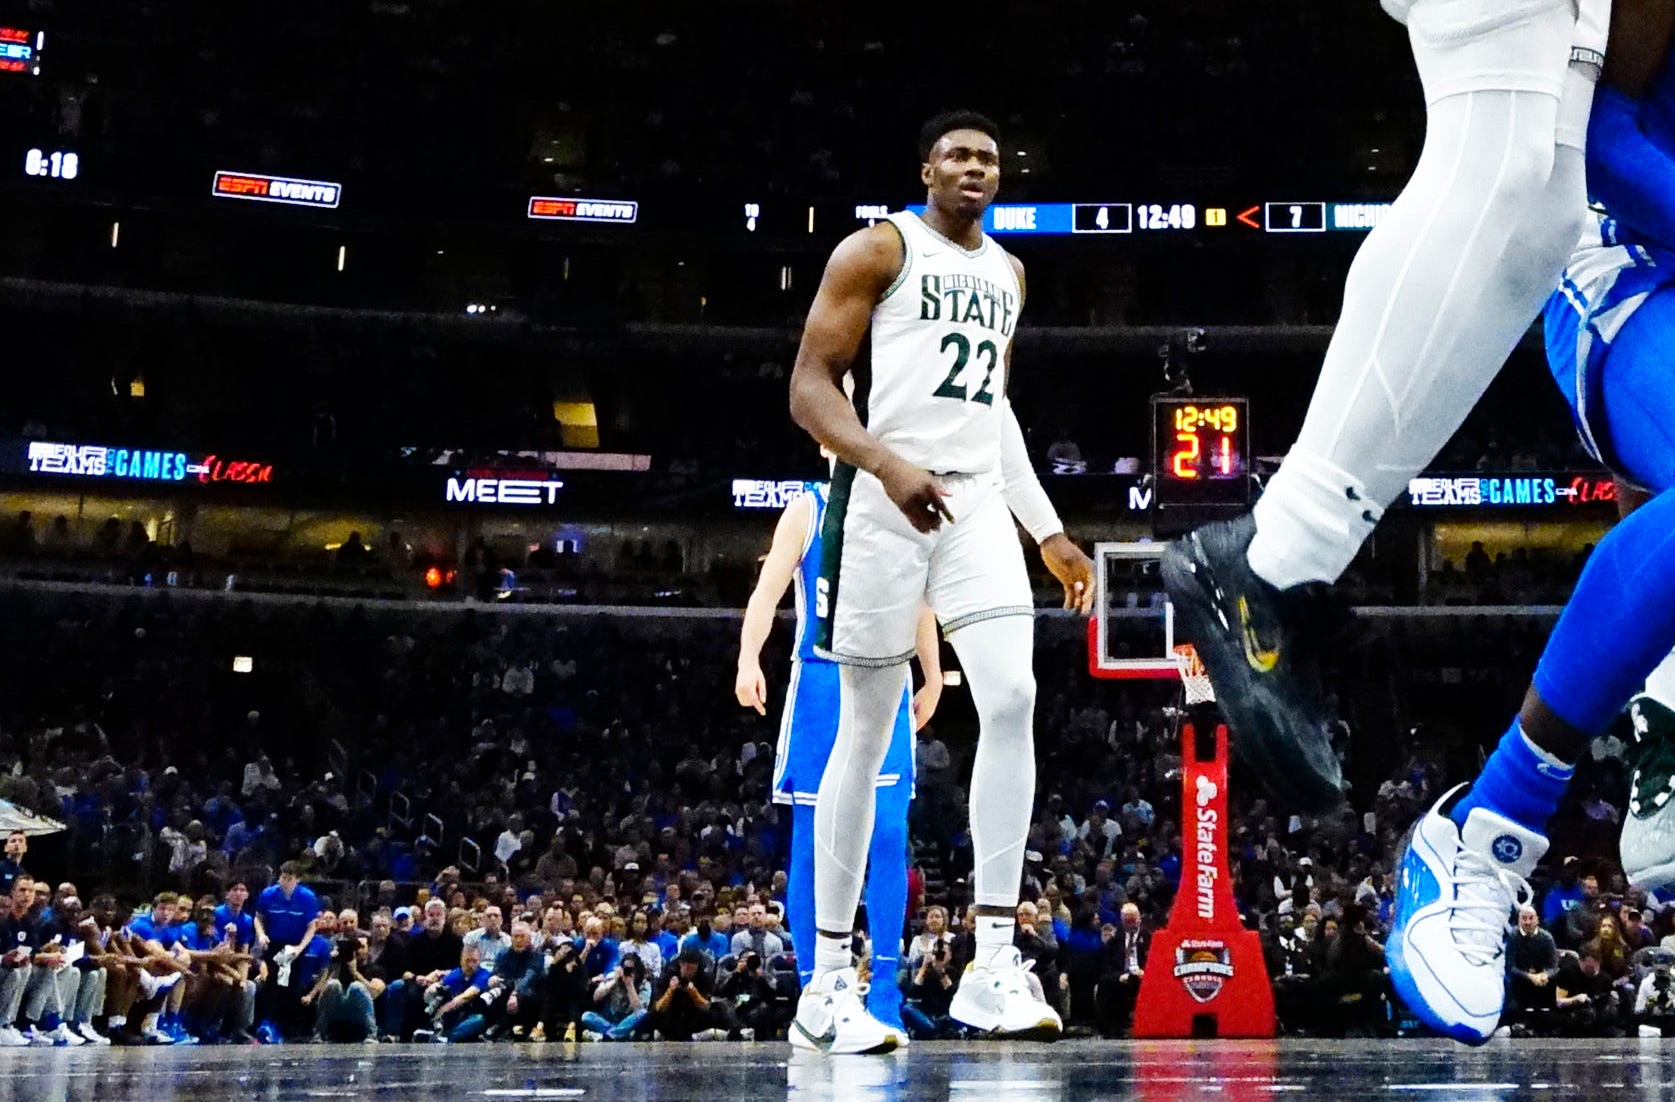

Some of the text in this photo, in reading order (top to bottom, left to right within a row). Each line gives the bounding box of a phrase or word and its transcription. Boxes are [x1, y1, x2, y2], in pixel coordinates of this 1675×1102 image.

[269, 181, 336, 203] EVENTS
[576, 203, 633, 218] EVENTS
[993, 207, 1036, 230] DUKE
[1095, 207, 1109, 229] 4
[1137, 204, 1195, 229] 12:49
[1290, 206, 1302, 228] 7
[920, 274, 1014, 337] STATE
[932, 332, 998, 410] 22
[1176, 407, 1237, 432] 12:49
[29, 454, 107, 475] TEAMS
[116, 450, 187, 480] GAMES
[446, 477, 563, 504] MEET
[1411, 487, 1482, 505] TEAMS
[1490, 478, 1555, 504] GAMES
